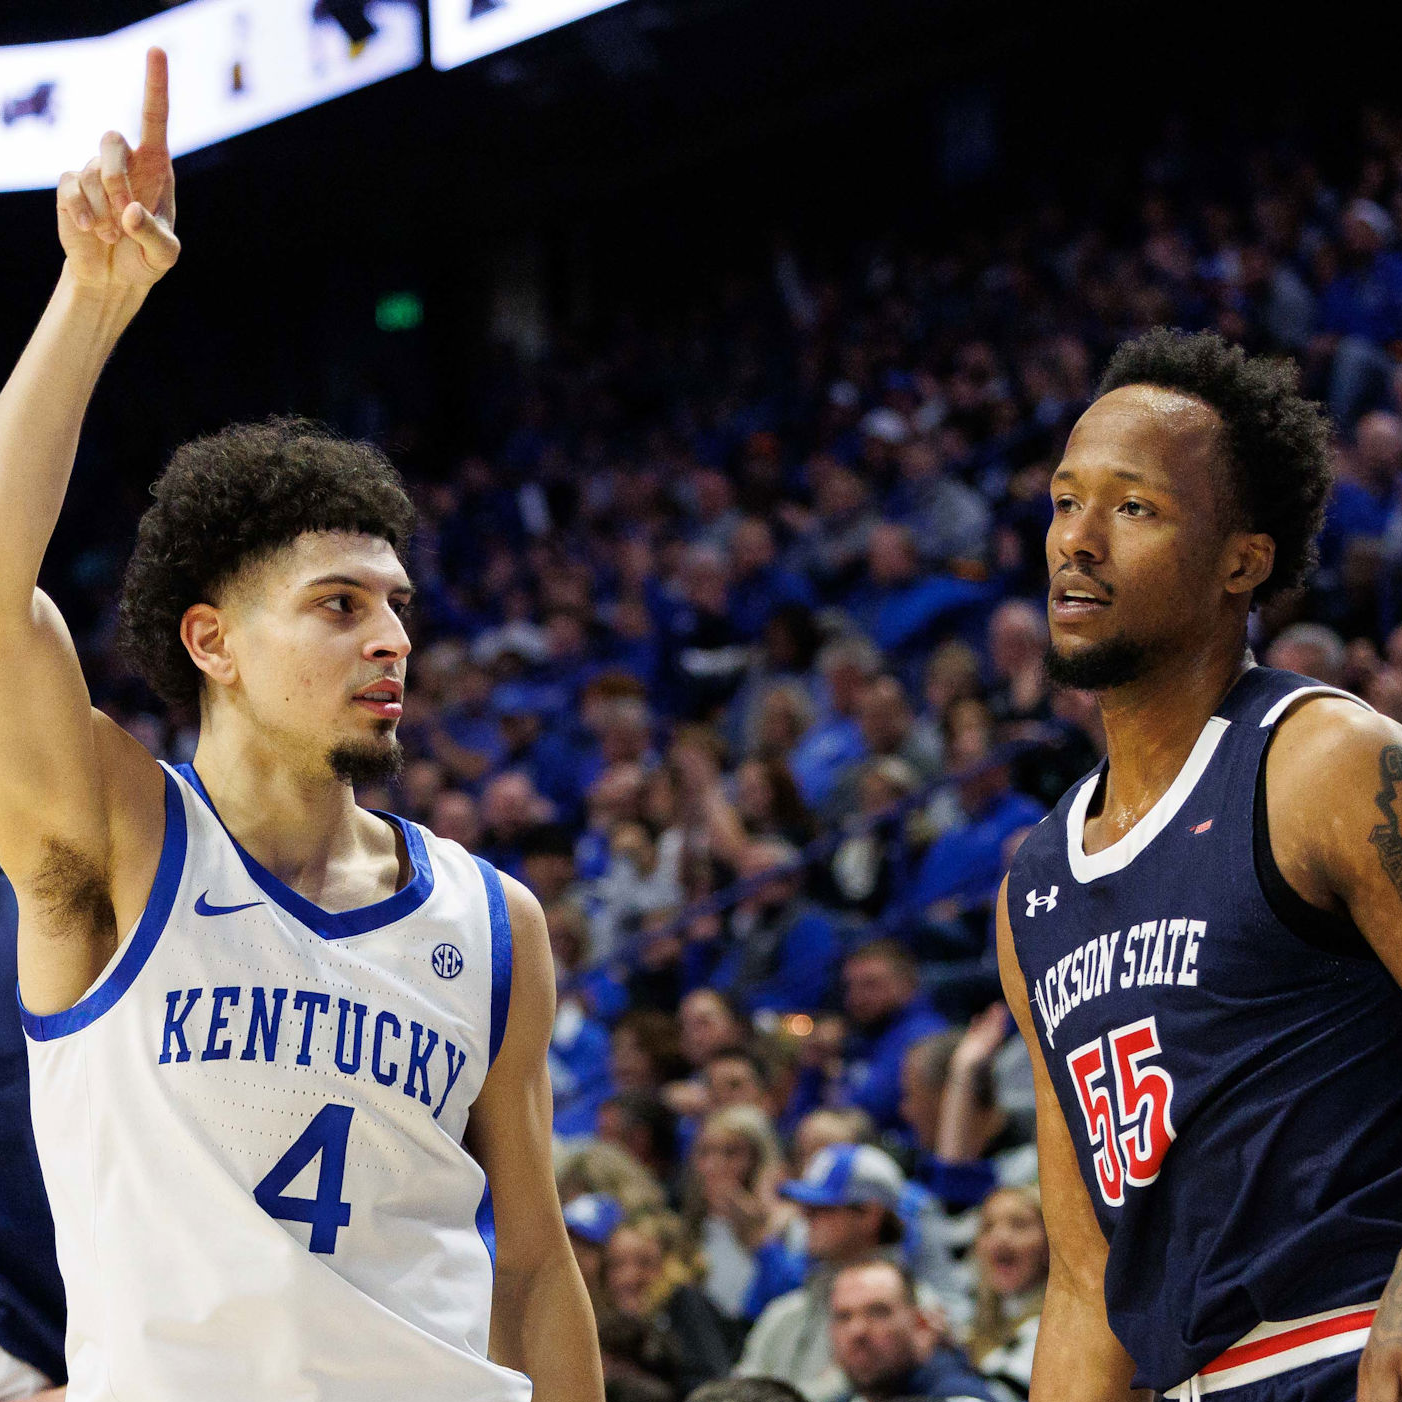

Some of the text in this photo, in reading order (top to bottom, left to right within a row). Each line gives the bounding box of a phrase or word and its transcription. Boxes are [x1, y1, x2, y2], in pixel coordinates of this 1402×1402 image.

[432, 944, 463, 978] SEC
[1120, 919, 1207, 989] STATE
[159, 986, 466, 1118] KENTUCKY
[1066, 1015, 1176, 1207] 55
[253, 1102, 355, 1254] 4
